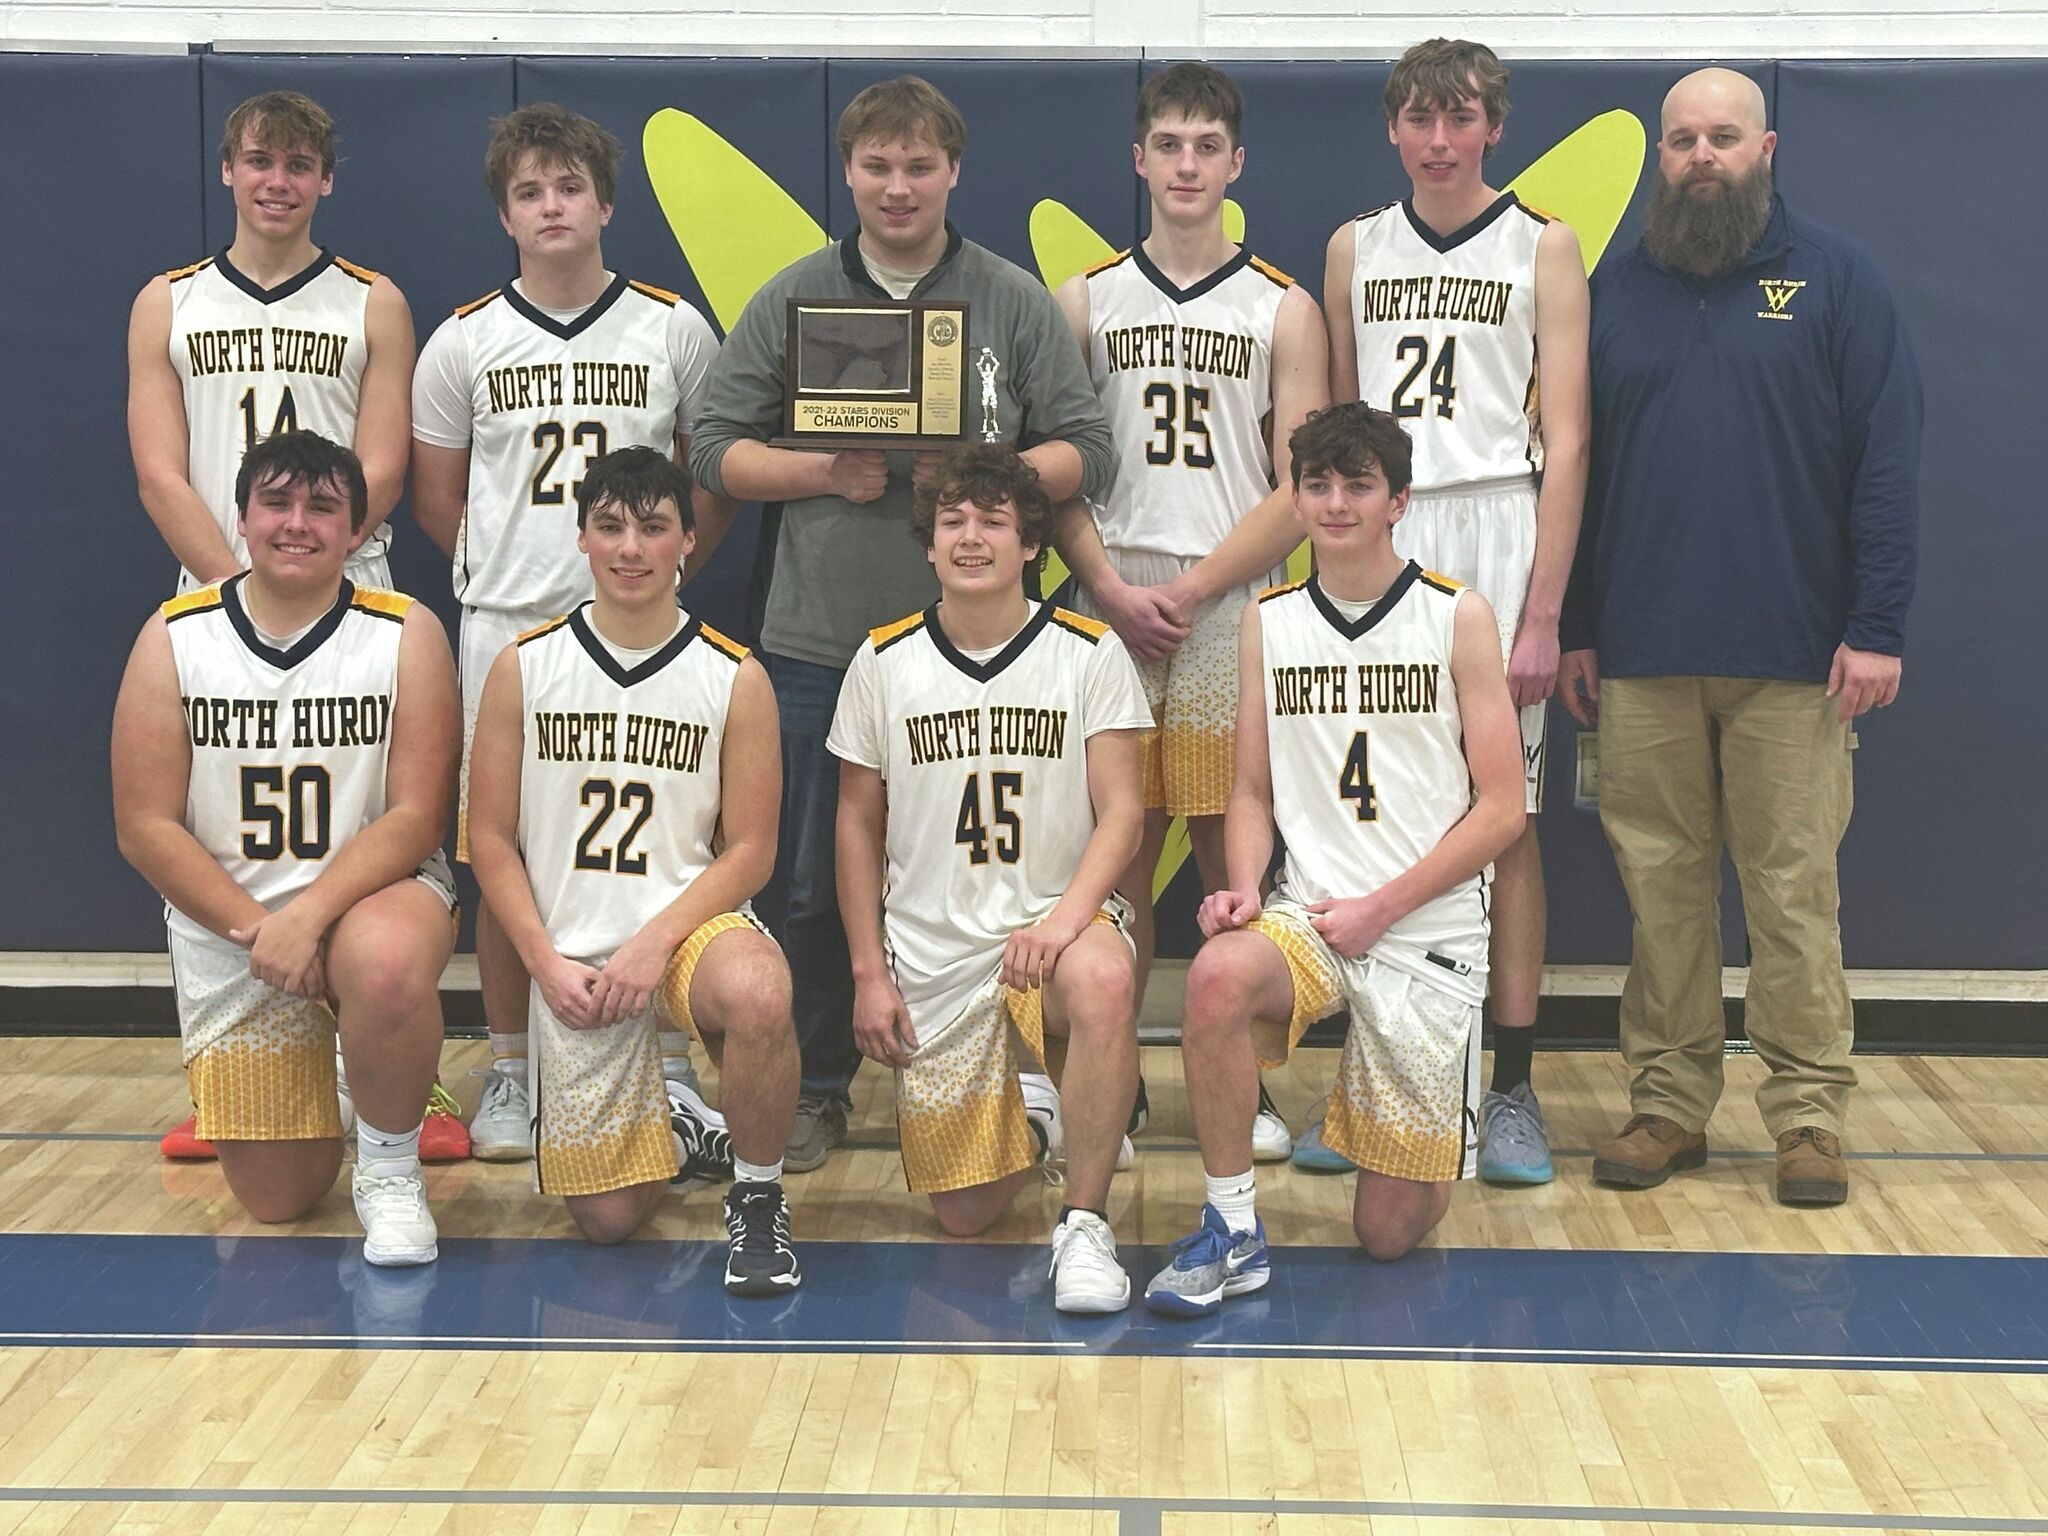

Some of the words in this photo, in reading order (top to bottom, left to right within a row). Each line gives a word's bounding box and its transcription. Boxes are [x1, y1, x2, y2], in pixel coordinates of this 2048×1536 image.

[1364, 276, 1433, 324] NORTH
[1433, 275, 1512, 326] HURON
[187, 327, 265, 377] NORTH
[272, 327, 348, 378] HURON
[1105, 324, 1175, 374] NORTH
[1181, 326, 1253, 380] HURON
[1391, 334, 1457, 422] 24
[487, 363, 563, 414] NORTH
[573, 362, 649, 409] HURON
[803, 405, 838, 414] 2021-22
[840, 406, 869, 415] STARS
[872, 407, 911, 416] DIVISION
[814, 415, 899, 428] CHAMPIONS
[1143, 381, 1216, 469] 35
[1273, 665, 1347, 715] NORTH
[1358, 664, 1439, 714] HURON
[535, 712, 617, 762] NORTH
[623, 714, 709, 773] HURON
[905, 708, 981, 765] NORTH
[990, 706, 1067, 759] HURON
[1339, 730, 1380, 823] 4
[239, 763, 332, 862] 50
[574, 777, 655, 877] 22
[955, 771, 1024, 867] 45
